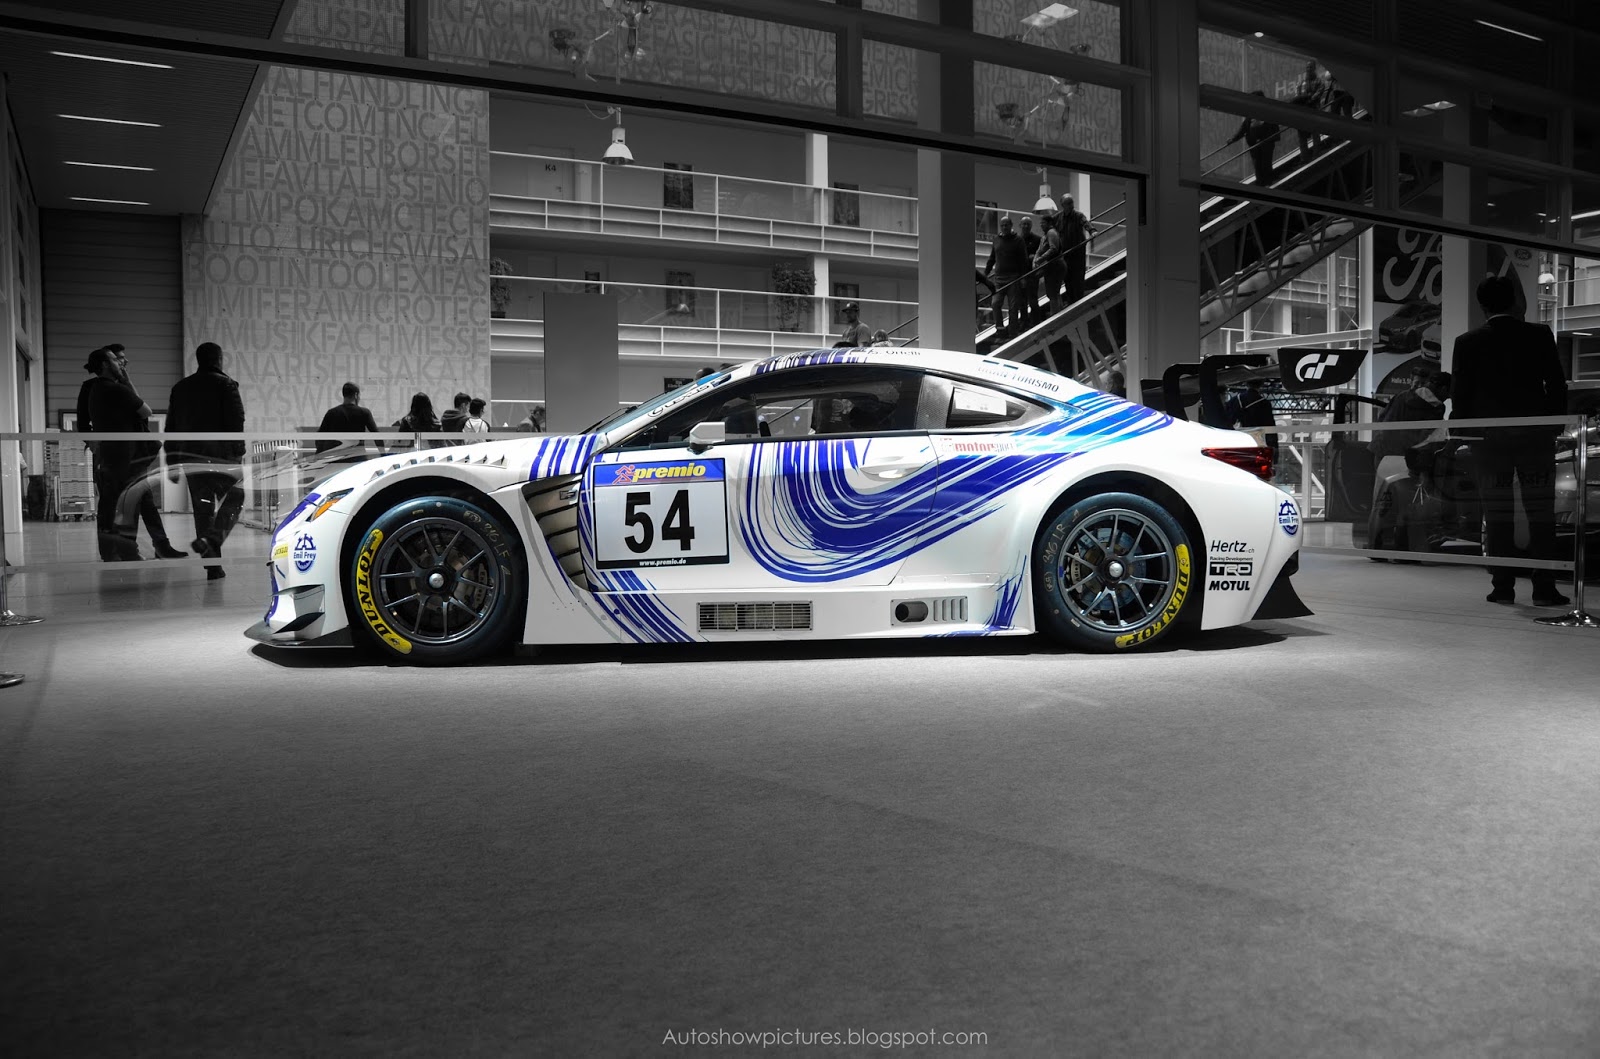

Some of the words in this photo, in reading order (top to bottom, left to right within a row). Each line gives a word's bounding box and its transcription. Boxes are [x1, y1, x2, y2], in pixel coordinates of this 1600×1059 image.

[631, 463, 706, 482] premio
[624, 489, 695, 553] 54
[293, 551, 303, 559] Emil
[304, 551, 316, 560] Frey
[639, 558, 687, 567] www.premio.de
[1208, 580, 1250, 591] MOTUL
